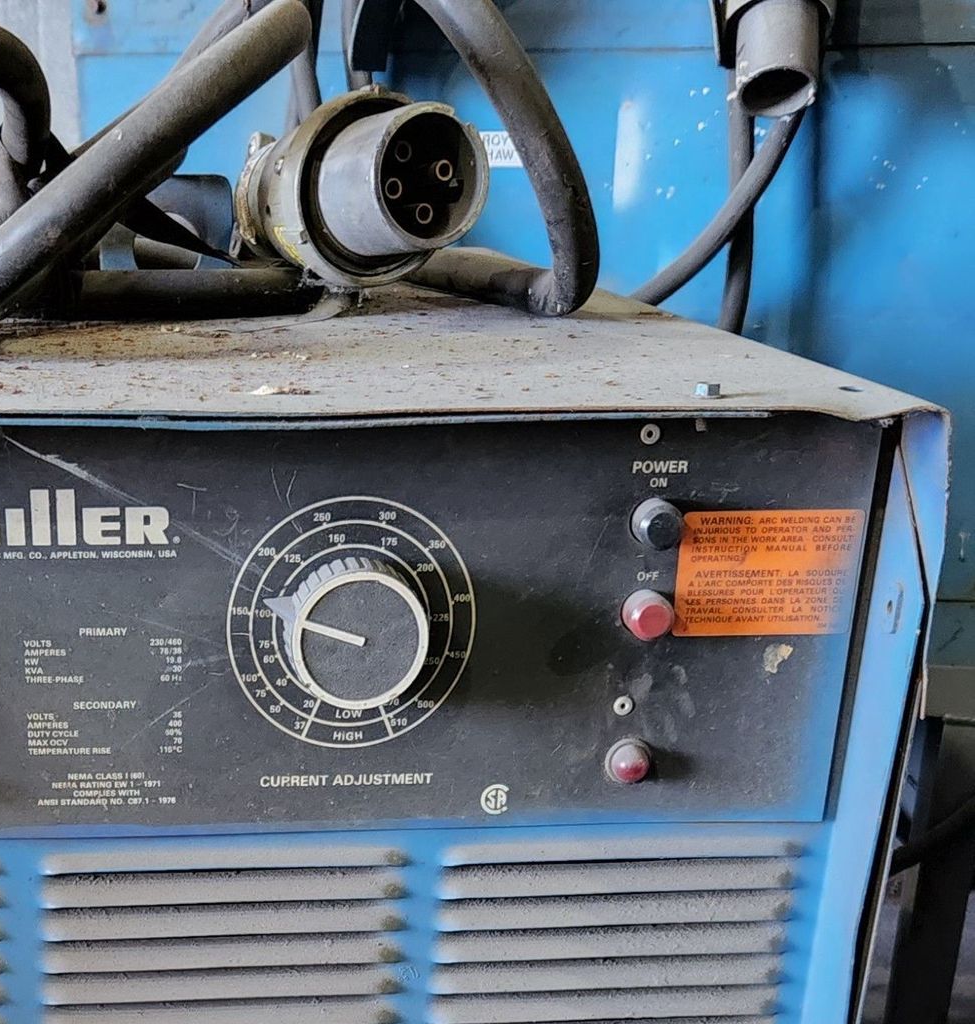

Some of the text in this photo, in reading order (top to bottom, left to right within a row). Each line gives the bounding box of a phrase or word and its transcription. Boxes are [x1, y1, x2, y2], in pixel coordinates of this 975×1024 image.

[632, 460, 688, 474] POWER
[650, 478, 668, 488] ON
[313, 512, 331, 521] 250
[379, 512, 396, 520] 300
[700, 516, 754, 525] WARNING:
[781, 516, 820, 524] WELDING
[693, 526, 741, 534] INJURIOUS
[761, 526, 807, 534] OPERATOR
[329, 534, 345, 543] 150
[381, 537, 397, 546] 175
[732, 536, 748, 544] THE
[428, 540, 445, 549] 350
[258, 548, 276, 556] 200
[691, 545, 758, 553] INSTRUCTION
[3, 551, 25, 560] MFG.
[158, 549, 177, 558] USA
[284, 554, 301, 563] 125
[416, 564, 434, 572] 200
[637, 572, 659, 582] OFF
[726, 579, 772, 587] COMPORTE
[687, 589, 735, 597] BLESSURES
[454, 594, 470, 602] 400
[232, 607, 248, 615] 150
[255, 609, 271, 618] 100
[732, 606, 784, 614] CONSULTER
[433, 613, 449, 622] 225
[685, 616, 733, 624] TECHNIQUE
[79, 627, 127, 637] PRIMARY
[259, 640, 270, 648] 75
[24, 649, 66, 657] AMPERES
[450, 650, 465, 658] 450
[24, 658, 38, 666] KW
[263, 655, 275, 663] 60
[25, 667, 43, 675] KVA
[275, 678, 287, 686] 40
[255, 690, 266, 698] 75
[73, 701, 137, 710] SECONDARY
[303, 700, 314, 708] 20
[269, 705, 281, 713] 50
[335, 709, 362, 718] LOW
[168, 720, 182, 728] 400
[294, 721, 305, 730] 37
[333, 731, 363, 741] HIGH
[173, 737, 182, 745] 70
[95, 772, 123, 780] CLASS
[260, 772, 433, 788] CURRENT ADJUSTMENT
[80, 781, 112, 789] RATING
[143, 780, 161, 788] 1971
[61, 798, 107, 806] STANDARD
